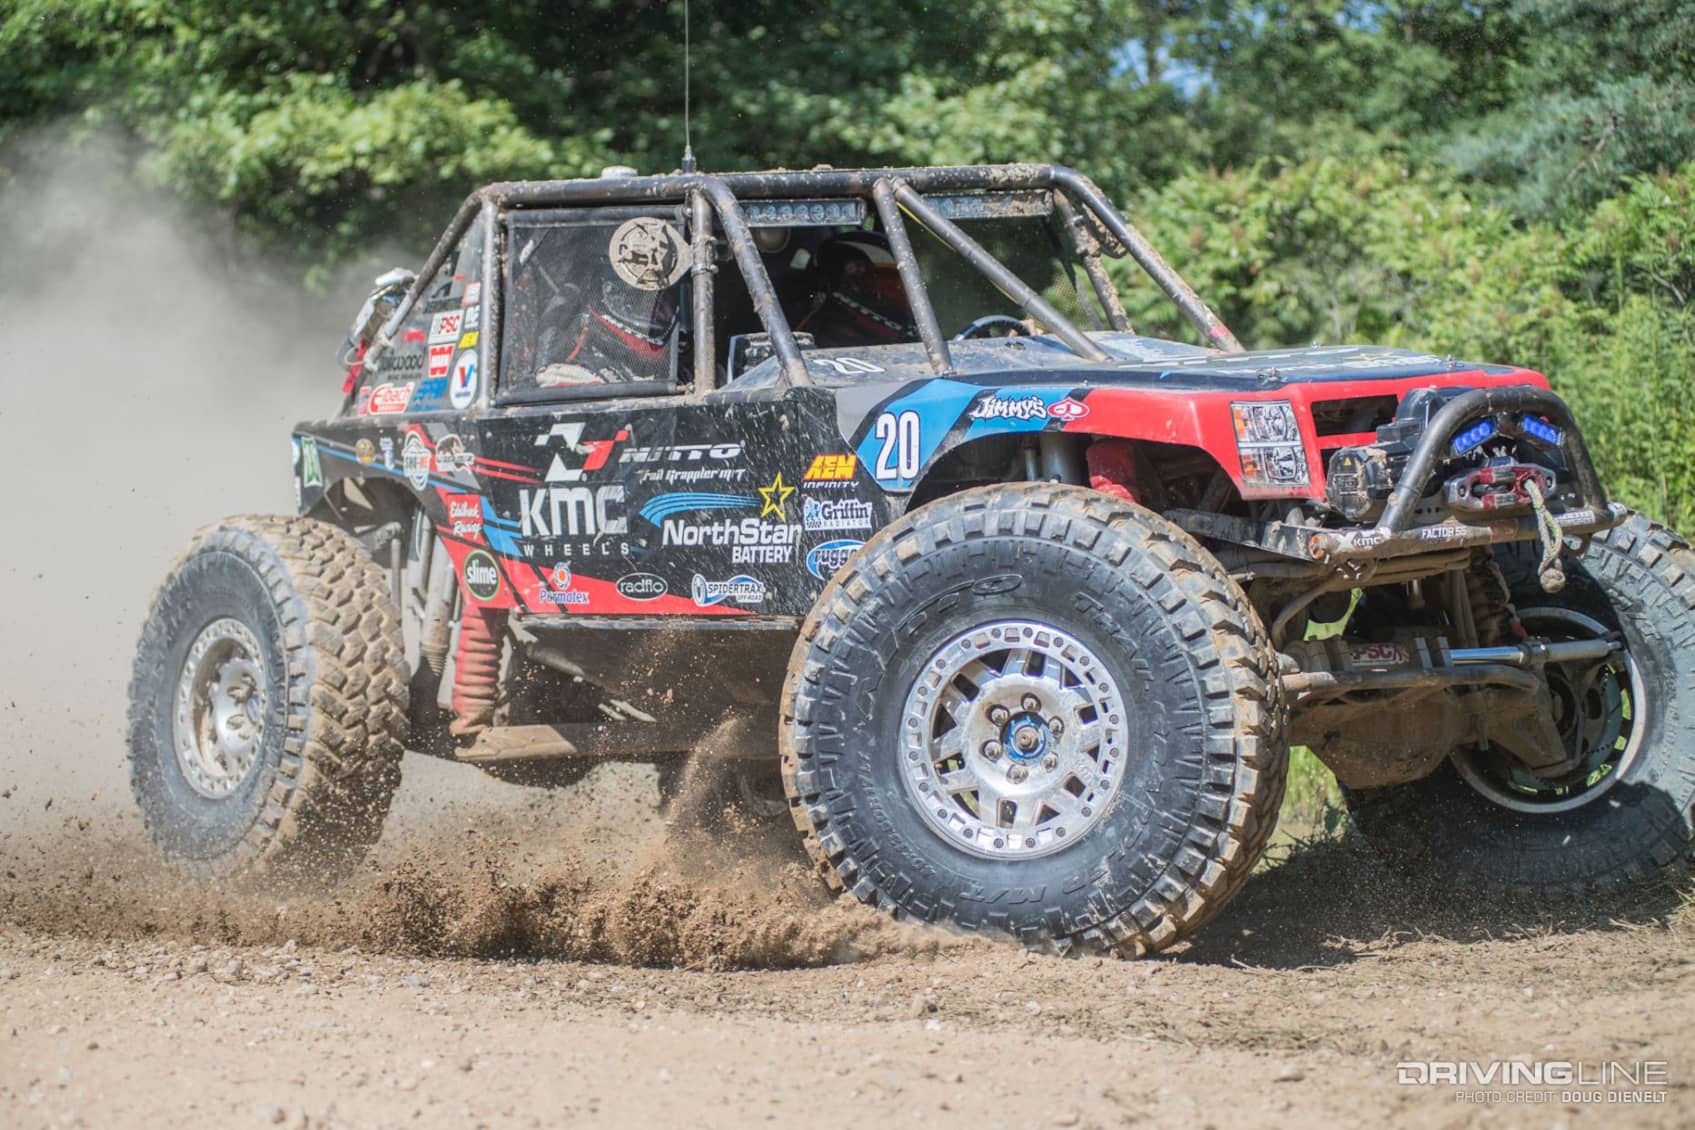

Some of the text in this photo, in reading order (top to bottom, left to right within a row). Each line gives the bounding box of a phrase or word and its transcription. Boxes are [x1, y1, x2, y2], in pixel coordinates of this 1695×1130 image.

[874, 410, 921, 482] 20
[802, 454, 858, 481] AEM
[821, 500, 870, 520] Griffin
[661, 517, 802, 547] NorthStar
[523, 542, 631, 558] WHEELS
[731, 545, 793, 565] BATTERY
[467, 560, 497, 587] slime
[619, 580, 666, 595] radflo
